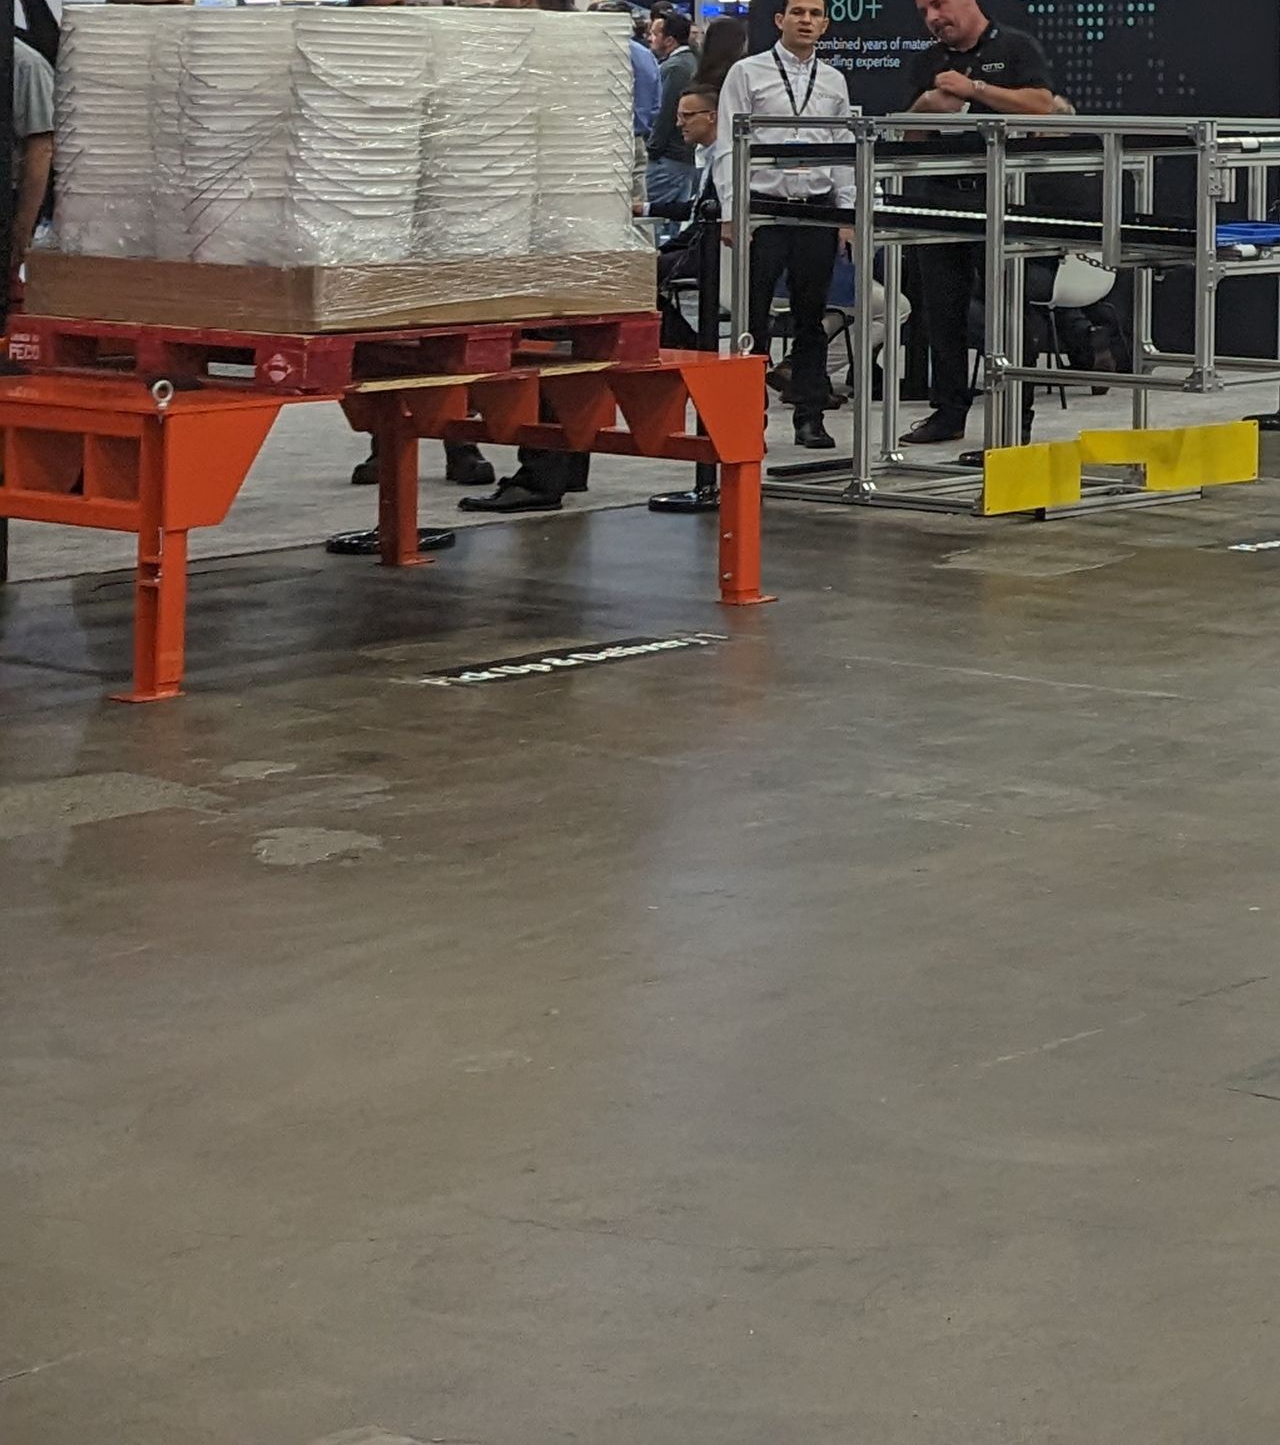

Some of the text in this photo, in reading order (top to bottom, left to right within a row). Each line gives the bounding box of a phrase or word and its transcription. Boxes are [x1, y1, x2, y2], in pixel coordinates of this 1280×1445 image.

[863, 40, 887, 52] years
[889, 37, 900, 50] of
[855, 57, 901, 69] expertise
